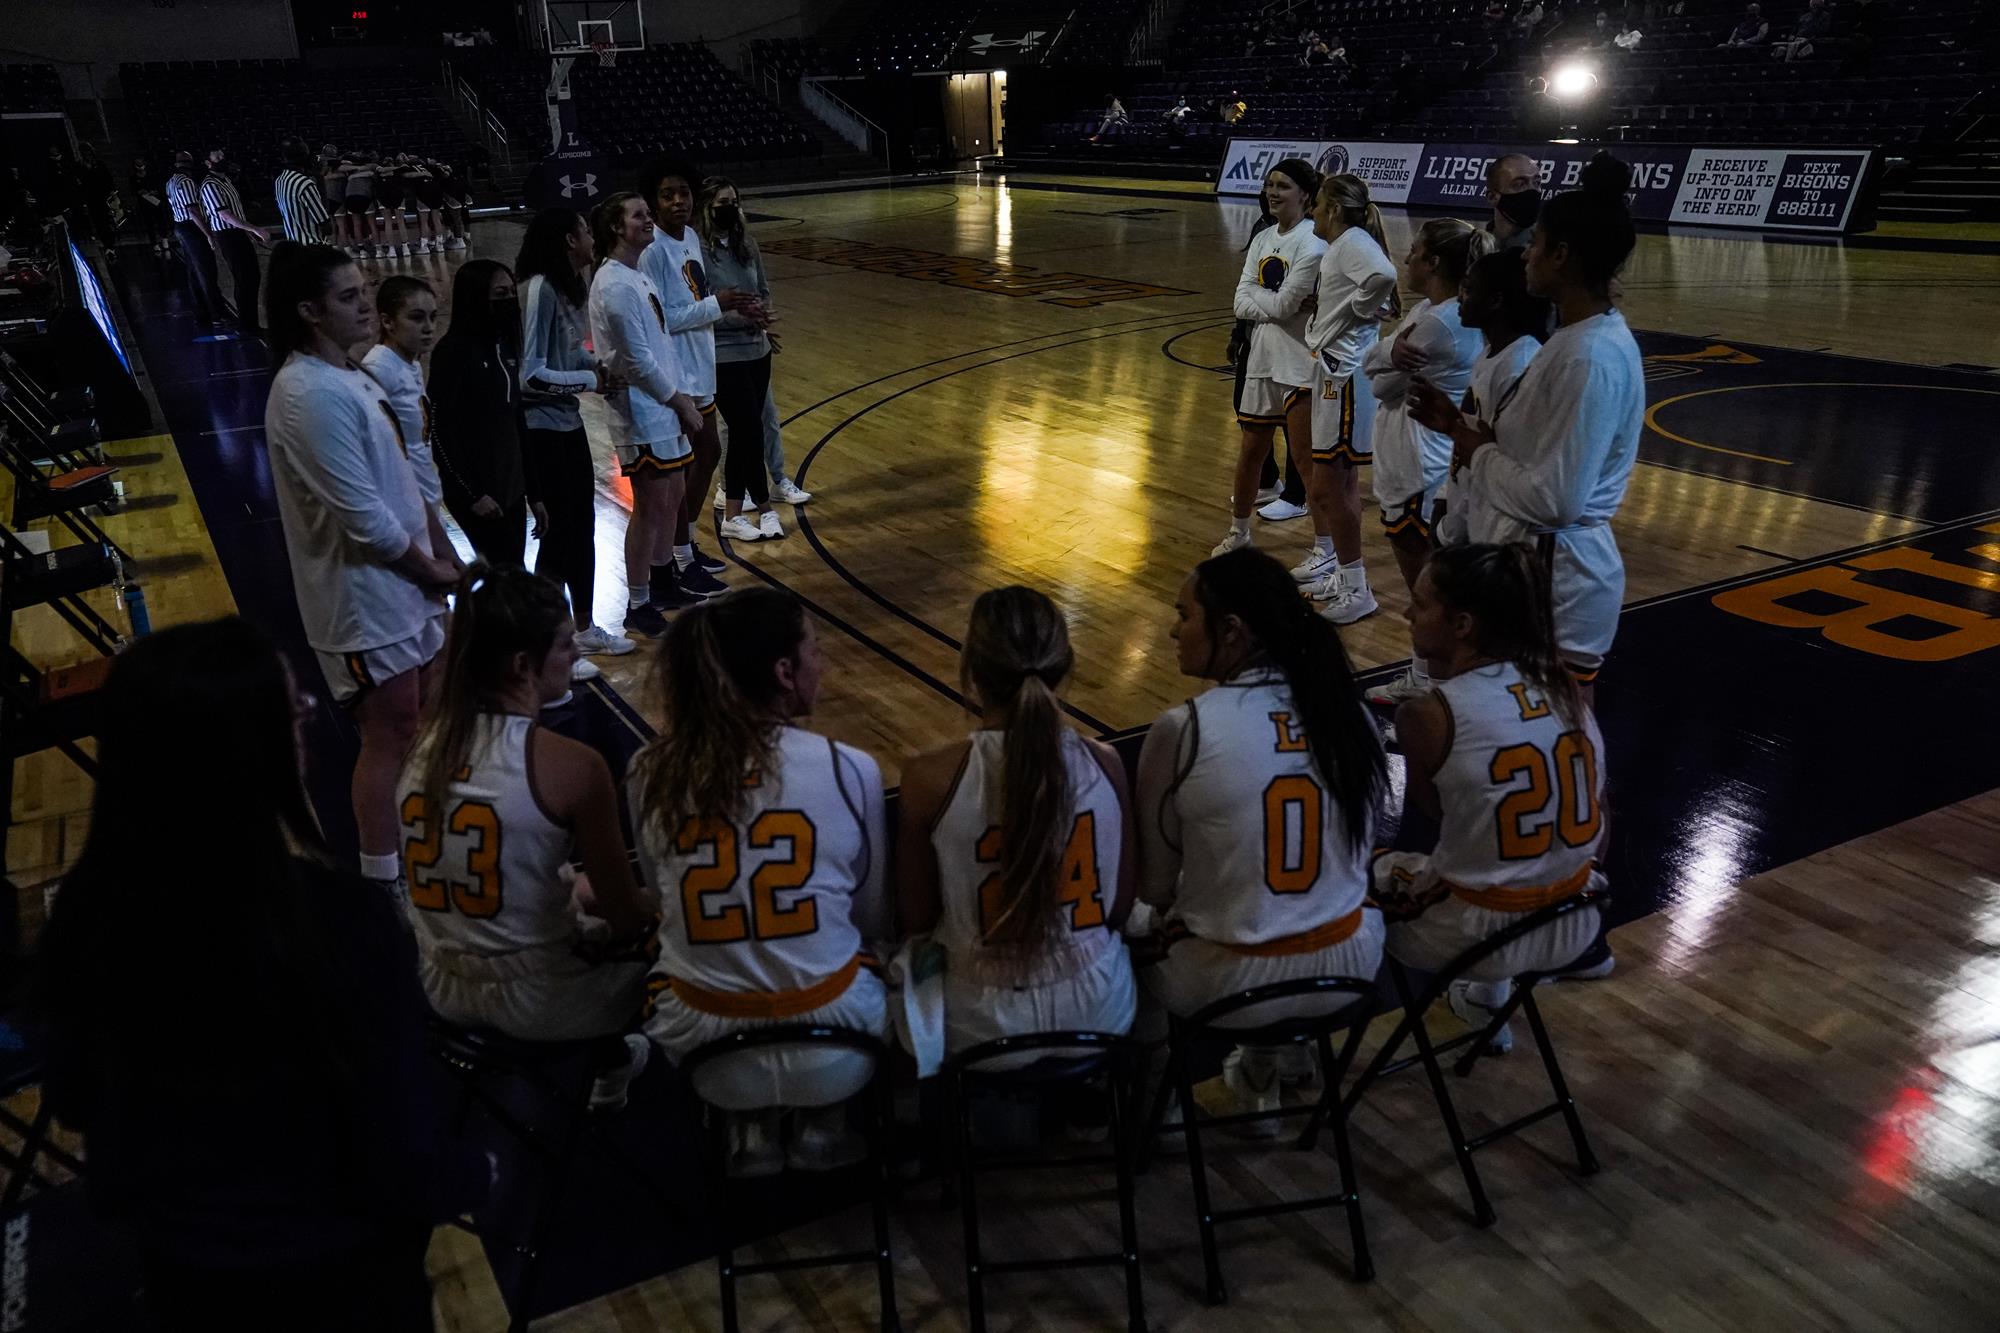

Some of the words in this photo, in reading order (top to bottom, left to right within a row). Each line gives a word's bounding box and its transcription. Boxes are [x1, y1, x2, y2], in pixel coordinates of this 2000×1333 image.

[567, 132, 580, 146] L
[1358, 157, 1407, 169] SUPPORT
[1701, 159, 1768, 172] RECEIVE
[1803, 162, 1842, 175] TEXT
[1350, 168, 1369, 180] THE
[1371, 169, 1410, 181] BISONS
[1423, 156, 1556, 184] LIPSCB
[1560, 160, 1674, 190] BNS
[1686, 173, 1777, 188] UP-TO-DATE
[1782, 174, 1851, 190] BISONS
[1440, 184, 1479, 197] ALLEN
[1694, 188, 1731, 200] INFO
[1734, 189, 1757, 201] ON
[1802, 190, 1821, 201] TO
[1682, 201, 1712, 214] THE
[1714, 203, 1761, 217] HERD!
[1776, 201, 1836, 218] 888111
[1323, 380, 1338, 400] L
[1506, 682, 1551, 722] L
[1268, 711, 1310, 753] L
[1489, 730, 1601, 861] 20
[1262, 773, 1323, 895] 0
[401, 792, 503, 920] 23
[676, 809, 820, 945] 22
